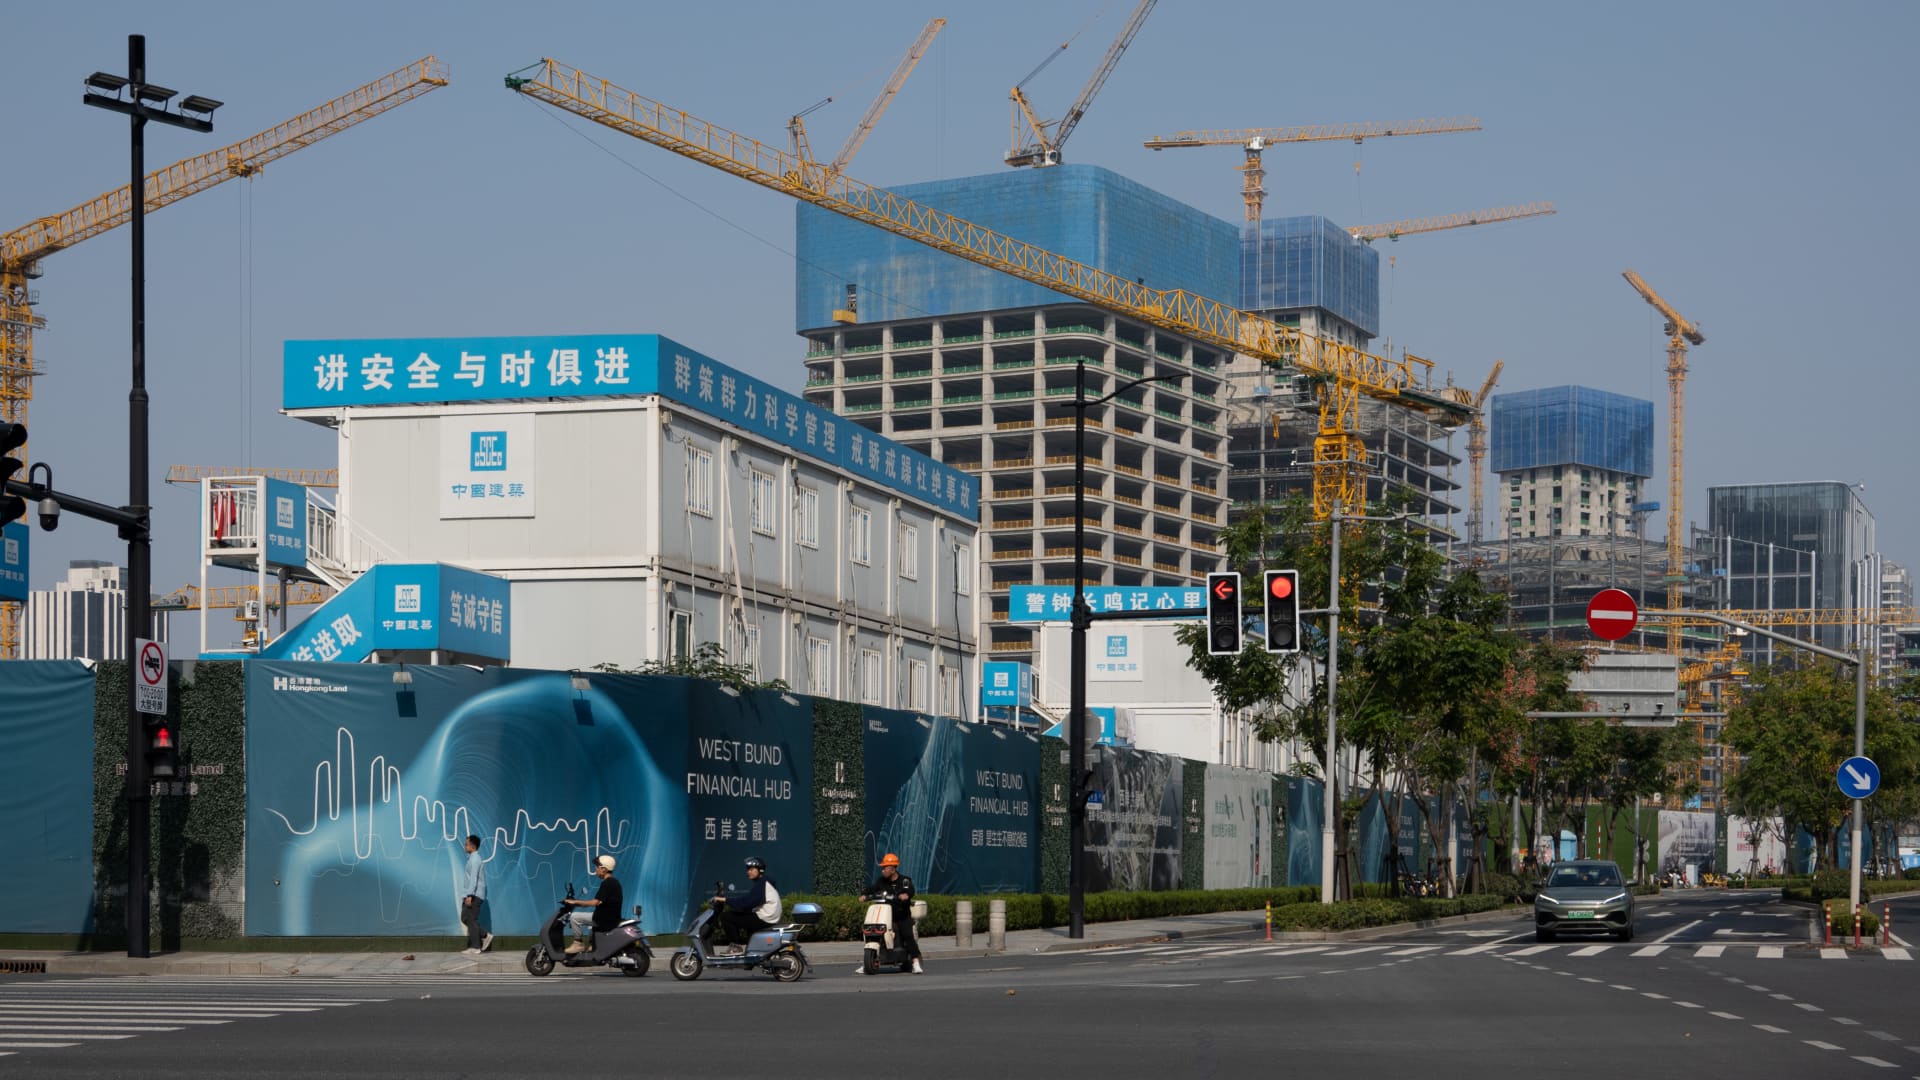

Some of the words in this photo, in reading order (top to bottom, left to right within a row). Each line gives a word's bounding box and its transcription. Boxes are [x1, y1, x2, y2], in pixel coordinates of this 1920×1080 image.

[313, 347, 630, 391] 讲安全与时俱进
[674, 354, 836, 454] 群策群力科学管理
[450, 590, 503, 635] 笃诚守信
[1025, 591, 1201, 614] 警钟长鸣记心里
[699, 737, 741, 762] WEST
[744, 743, 782, 766] BUND
[687, 773, 761, 798] FINANCIAL
[764, 780, 792, 800] HUB
[976, 769, 1000, 788] WEST
[1001, 772, 1023, 790] BUND
[970, 796, 1012, 815] FINANCIAL
[1012, 800, 1029, 817] HUB
[704, 816, 778, 841] 西岸金融城
